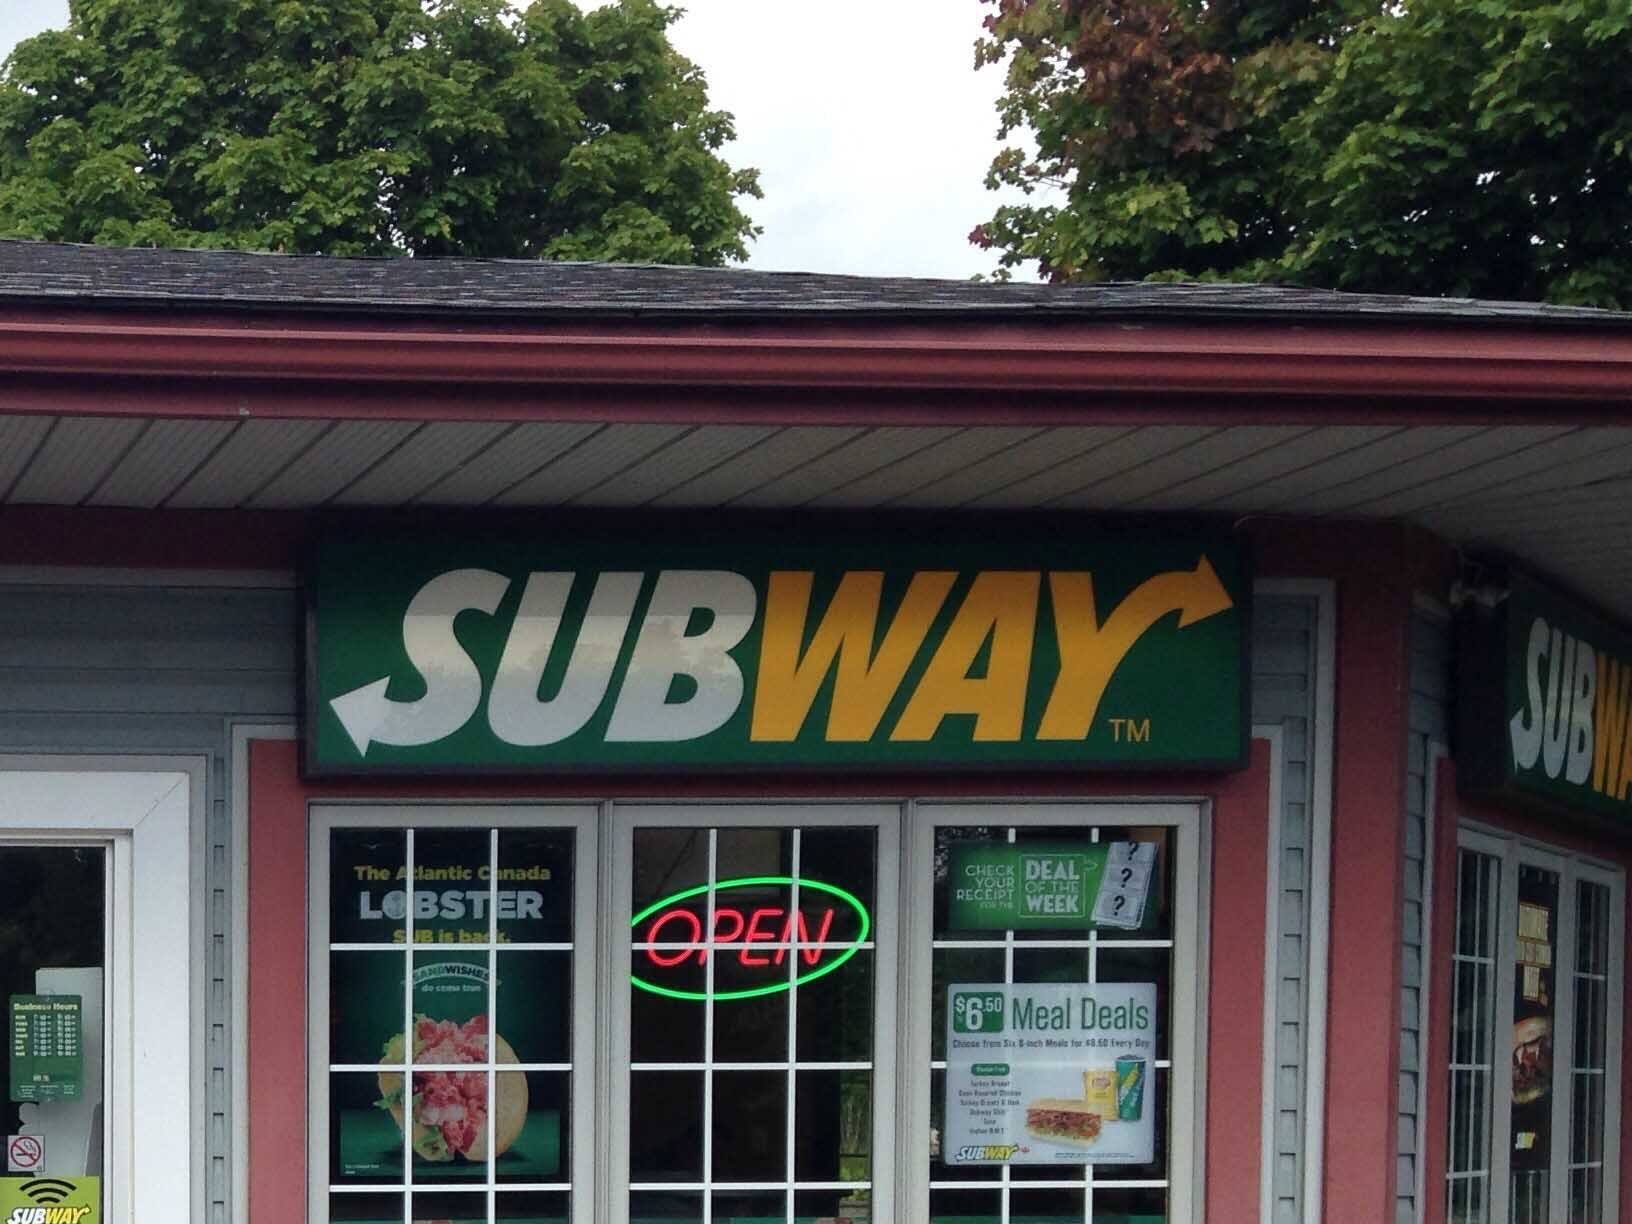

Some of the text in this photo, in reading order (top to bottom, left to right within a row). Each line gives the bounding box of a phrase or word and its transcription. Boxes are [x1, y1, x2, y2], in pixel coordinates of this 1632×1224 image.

[329, 555, 1233, 757] SUBWAY
[1510, 617, 1632, 800] SUBW
[1108, 718, 1151, 743] TM
[353, 866, 390, 881] The
[396, 866, 472, 881] Alantic
[965, 864, 1015, 877] CHECK
[1024, 859, 1081, 881] DEAL
[975, 877, 1015, 889] YOUR
[1025, 881, 1080, 894] OF THE
[359, 890, 544, 920] LOBSTER
[956, 889, 1015, 901] RECEIPT
[1026, 894, 1080, 913] WEEK
[646, 908, 835, 966] OPEN
[1012, 997, 1071, 1031] Meal
[1080, 997, 1149, 1031] Deals
[956, 1144, 1019, 1162] SUBWAY
